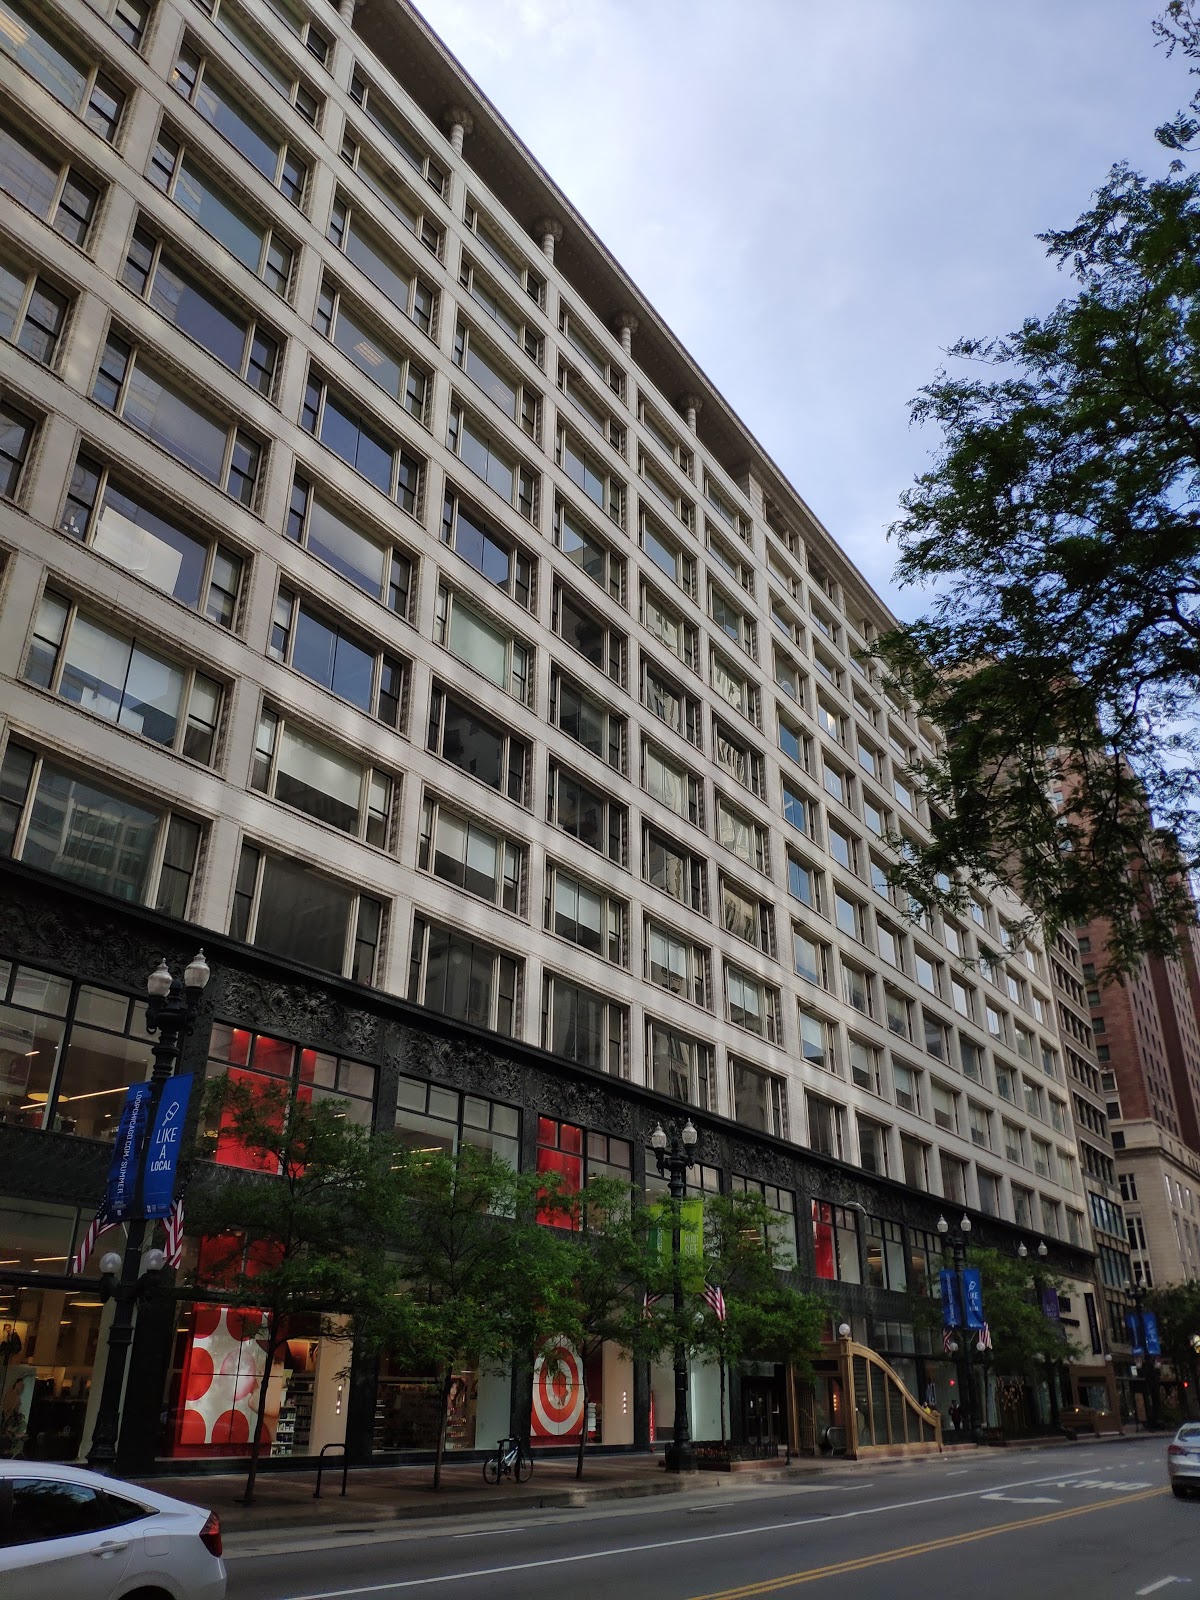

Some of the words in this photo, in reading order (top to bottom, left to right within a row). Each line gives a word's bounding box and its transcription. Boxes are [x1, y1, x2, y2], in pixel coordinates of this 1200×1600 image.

[156, 1127, 178, 1144] LIKE
[159, 1144, 166, 1159] A
[150, 1160, 171, 1172] LOCAL
